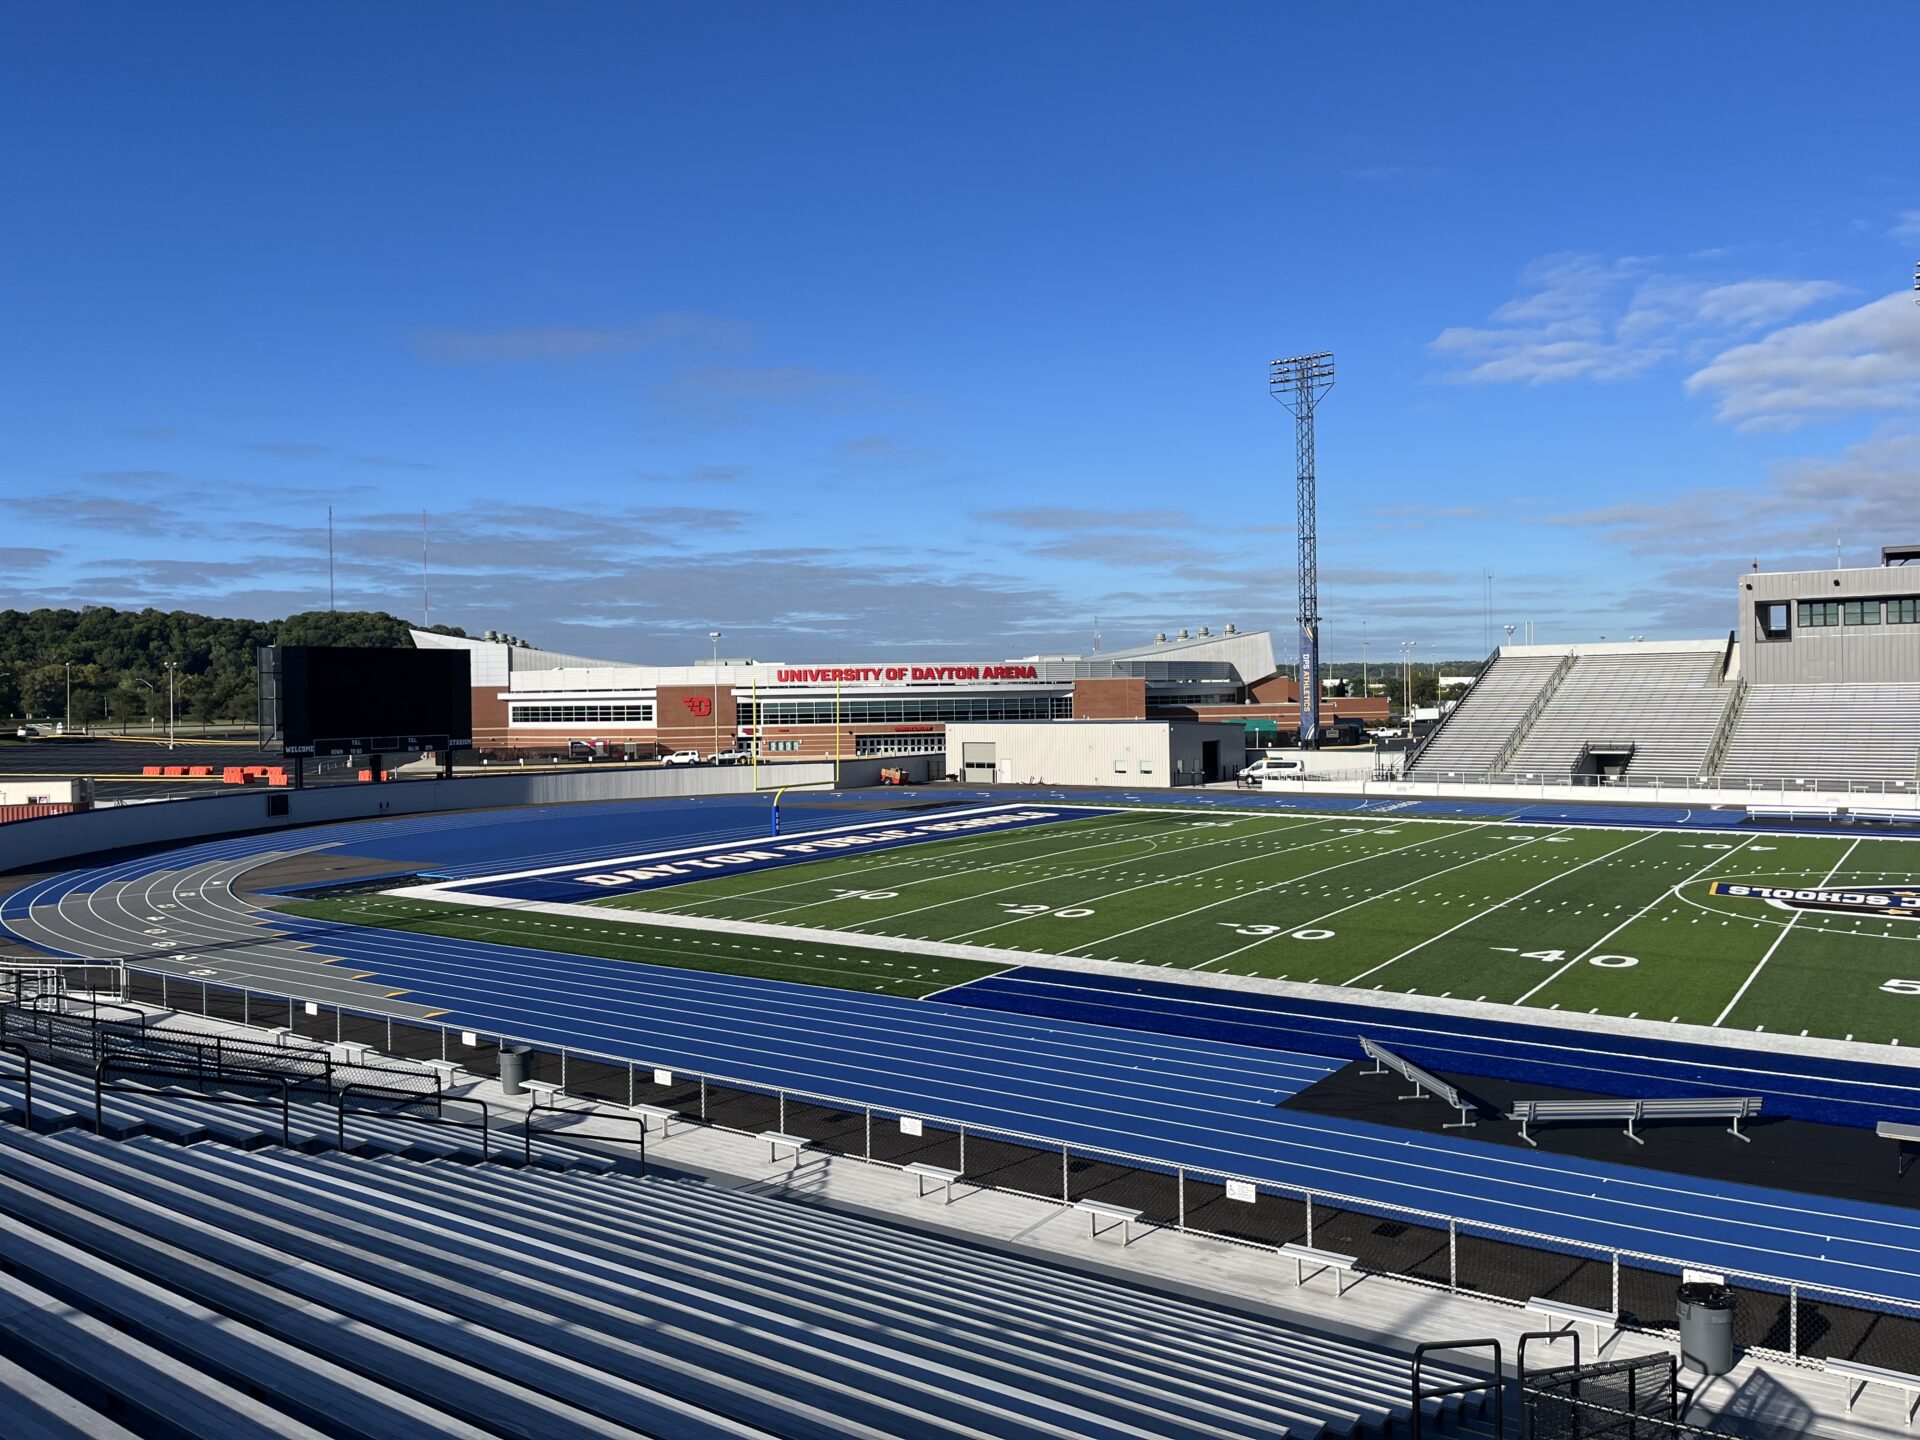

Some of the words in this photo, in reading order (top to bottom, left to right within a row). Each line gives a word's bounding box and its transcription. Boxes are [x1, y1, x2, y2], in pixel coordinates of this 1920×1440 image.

[1302, 653, 1310, 670] DPS
[777, 669, 882, 682] UNIVERSITY
[885, 668, 909, 680] OF
[911, 667, 980, 680] DAYTON
[982, 665, 1038, 679] ARENA
[1303, 671, 1311, 713] ATHLETICS
[285, 745, 315, 754] WELCOME
[573, 850, 787, 886] DAYTON
[773, 829, 929, 853] PUBLIC
[1728, 884, 1892, 906] SCHOOLS
[1003, 904, 1096, 918] 20
[1235, 924, 1336, 940] 30
[1519, 950, 1640, 968] 40
